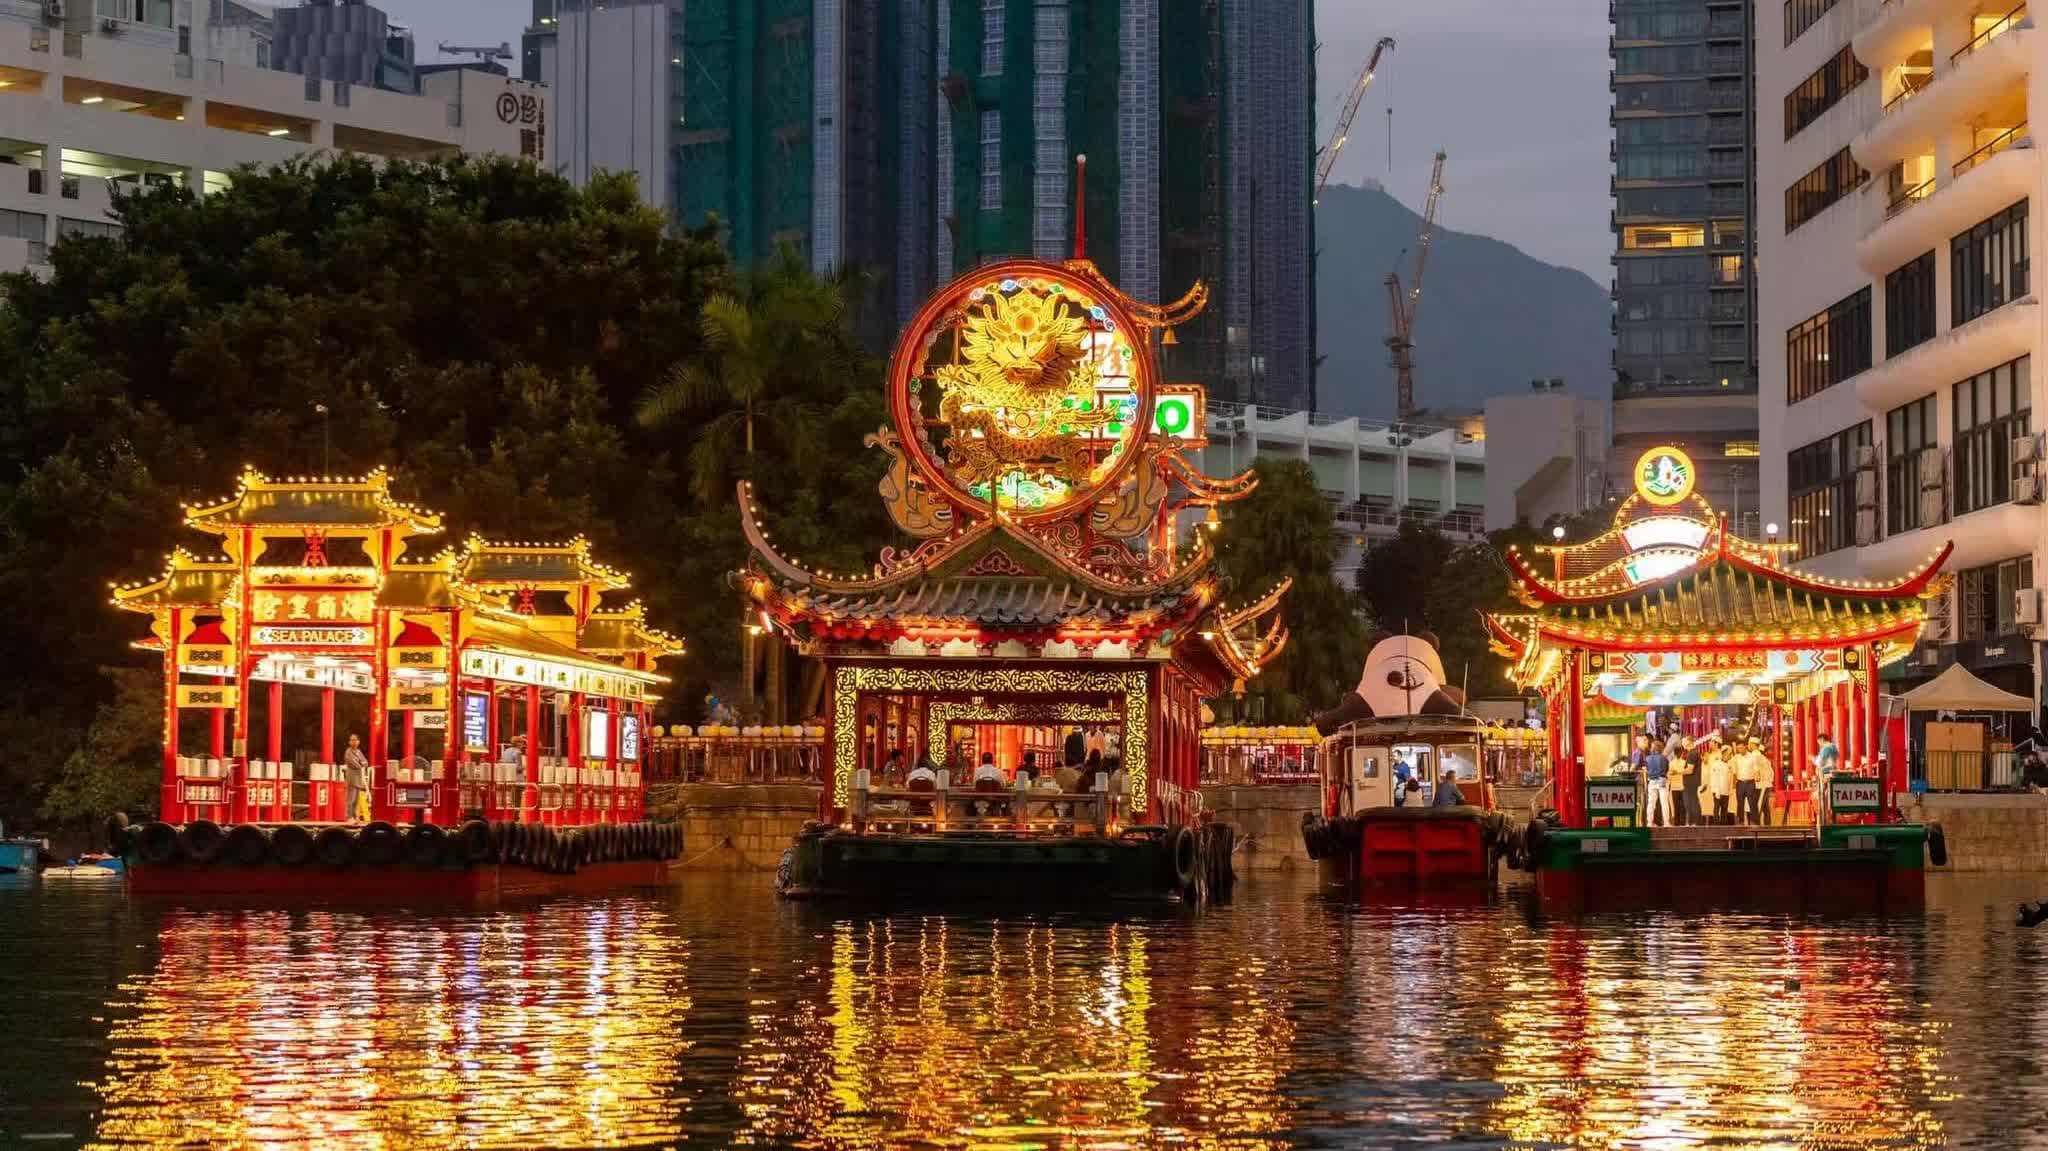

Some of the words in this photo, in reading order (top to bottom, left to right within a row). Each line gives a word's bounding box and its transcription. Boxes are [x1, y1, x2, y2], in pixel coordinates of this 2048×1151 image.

[271, 630, 296, 643] SEA
[303, 630, 354, 643] PALACE
[1592, 792, 1609, 804] TAI
[1611, 792, 1634, 804] PAK
[1836, 789, 1853, 801] TAI
[1855, 789, 1877, 801] PAK
